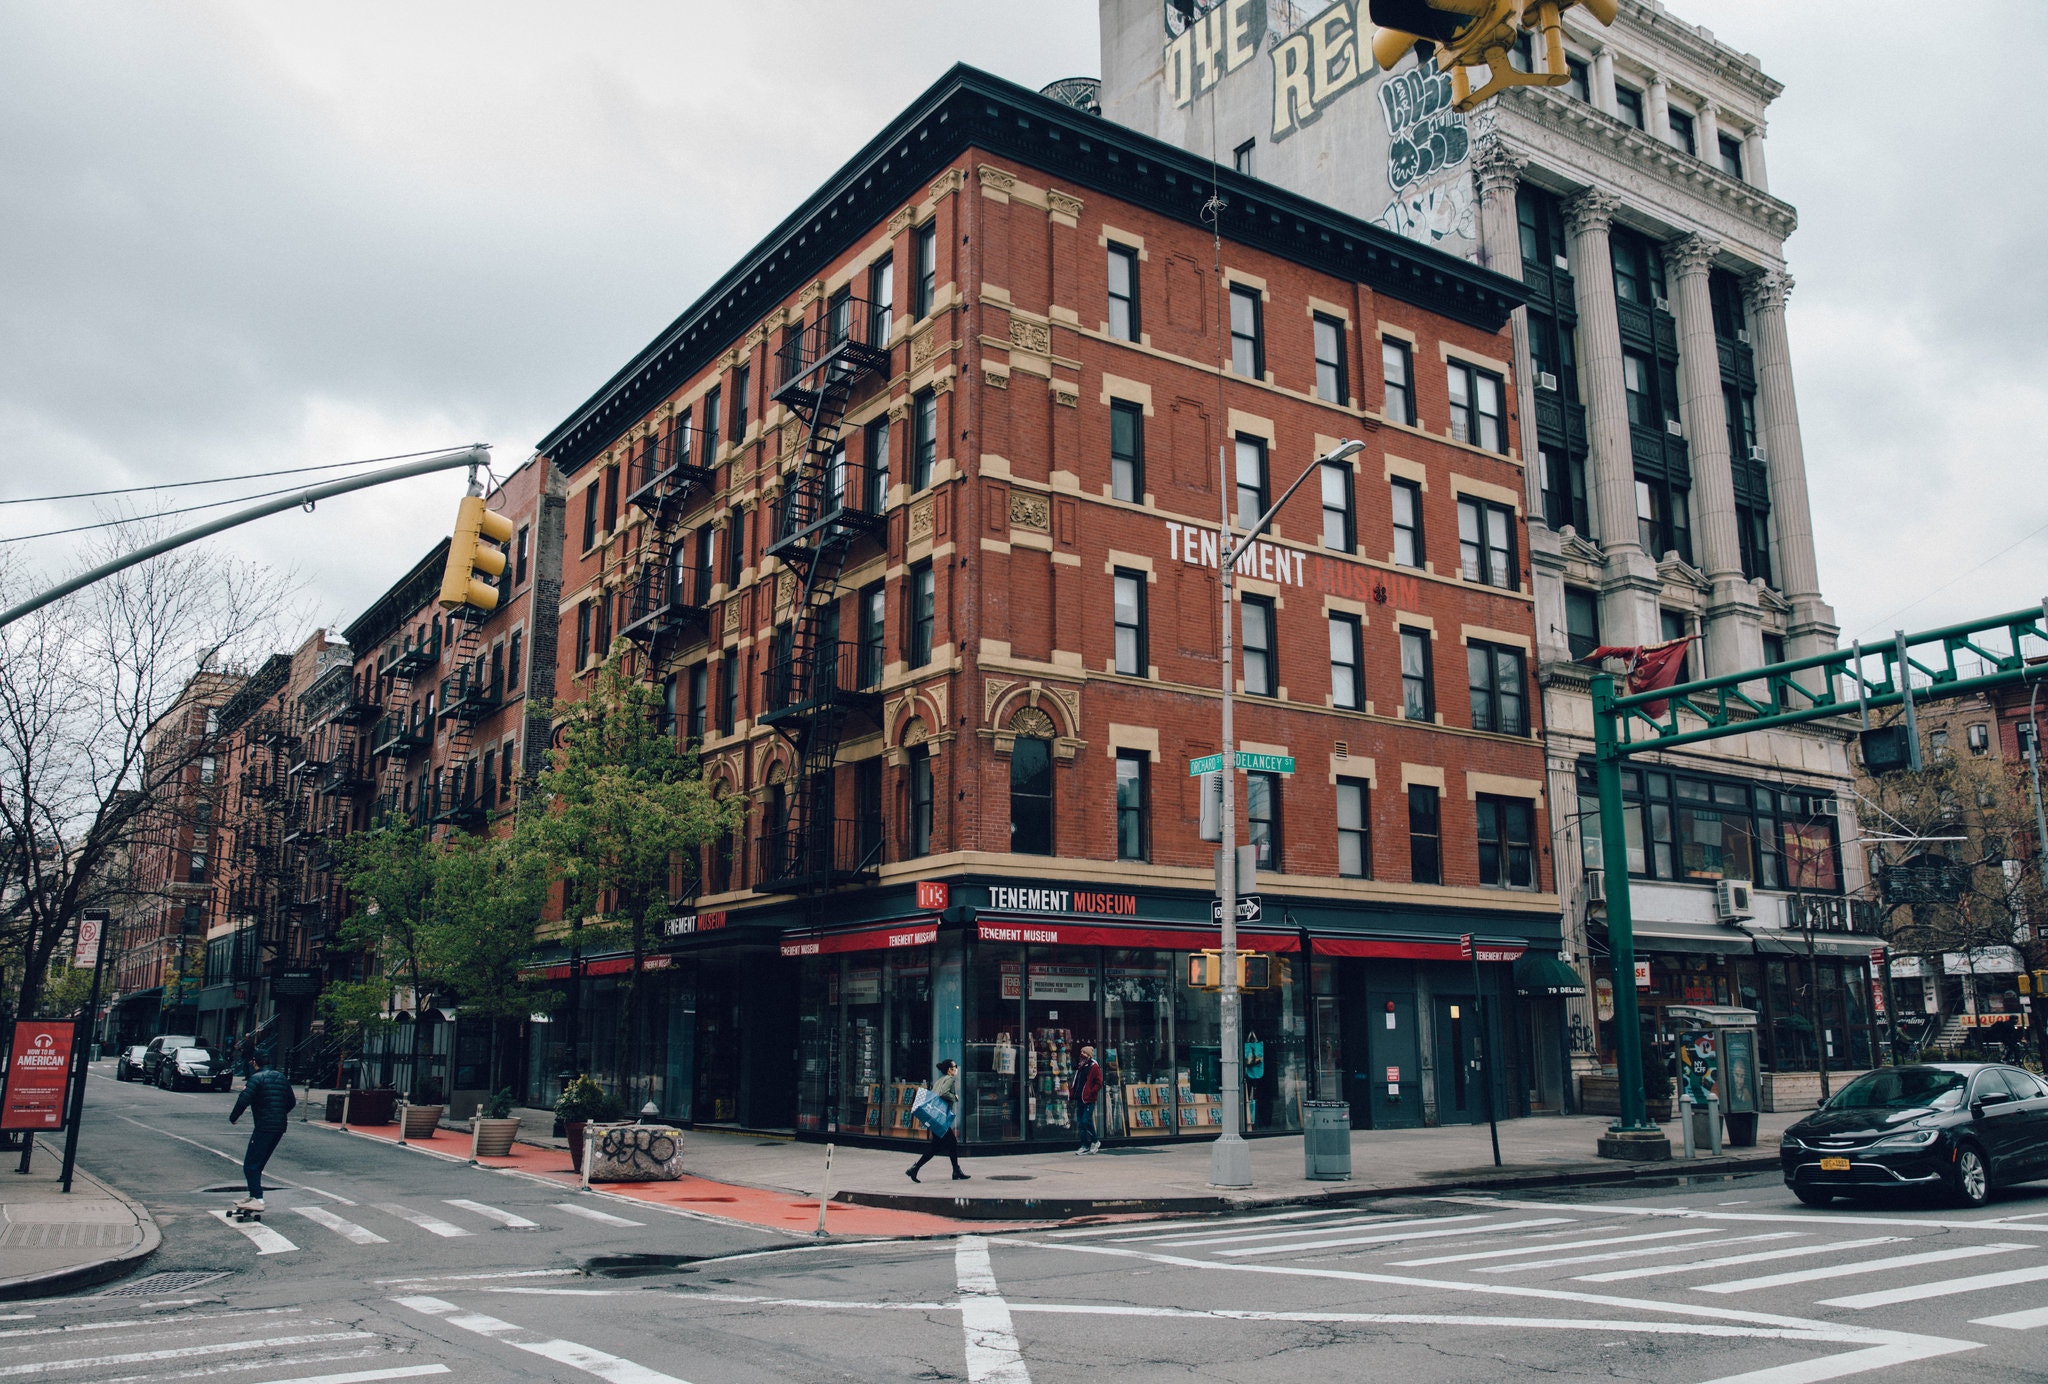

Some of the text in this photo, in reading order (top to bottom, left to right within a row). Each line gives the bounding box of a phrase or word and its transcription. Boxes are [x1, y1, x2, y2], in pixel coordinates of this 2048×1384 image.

[1165, 521, 1419, 611] TENMENT MUSEUM
[1191, 757, 1216, 774] ORCHARD
[1236, 753, 1292, 770] DELANCEY ST
[989, 886, 1136, 915] TENEMENT MUSEUM
[1239, 903, 1255, 915] WAY
[697, 911, 727, 931] MUSEUM
[888, 931, 937, 947] TENEMENT MUSEUM
[979, 927, 1058, 943] TENEMENT MUSEUM
[801, 943, 820, 954] MUSEUM
[1476, 951, 1503, 961] TENEMENT
[1560, 986, 1586, 994] DELANCE
[17, 1055, 65, 1066] AMERICAN
